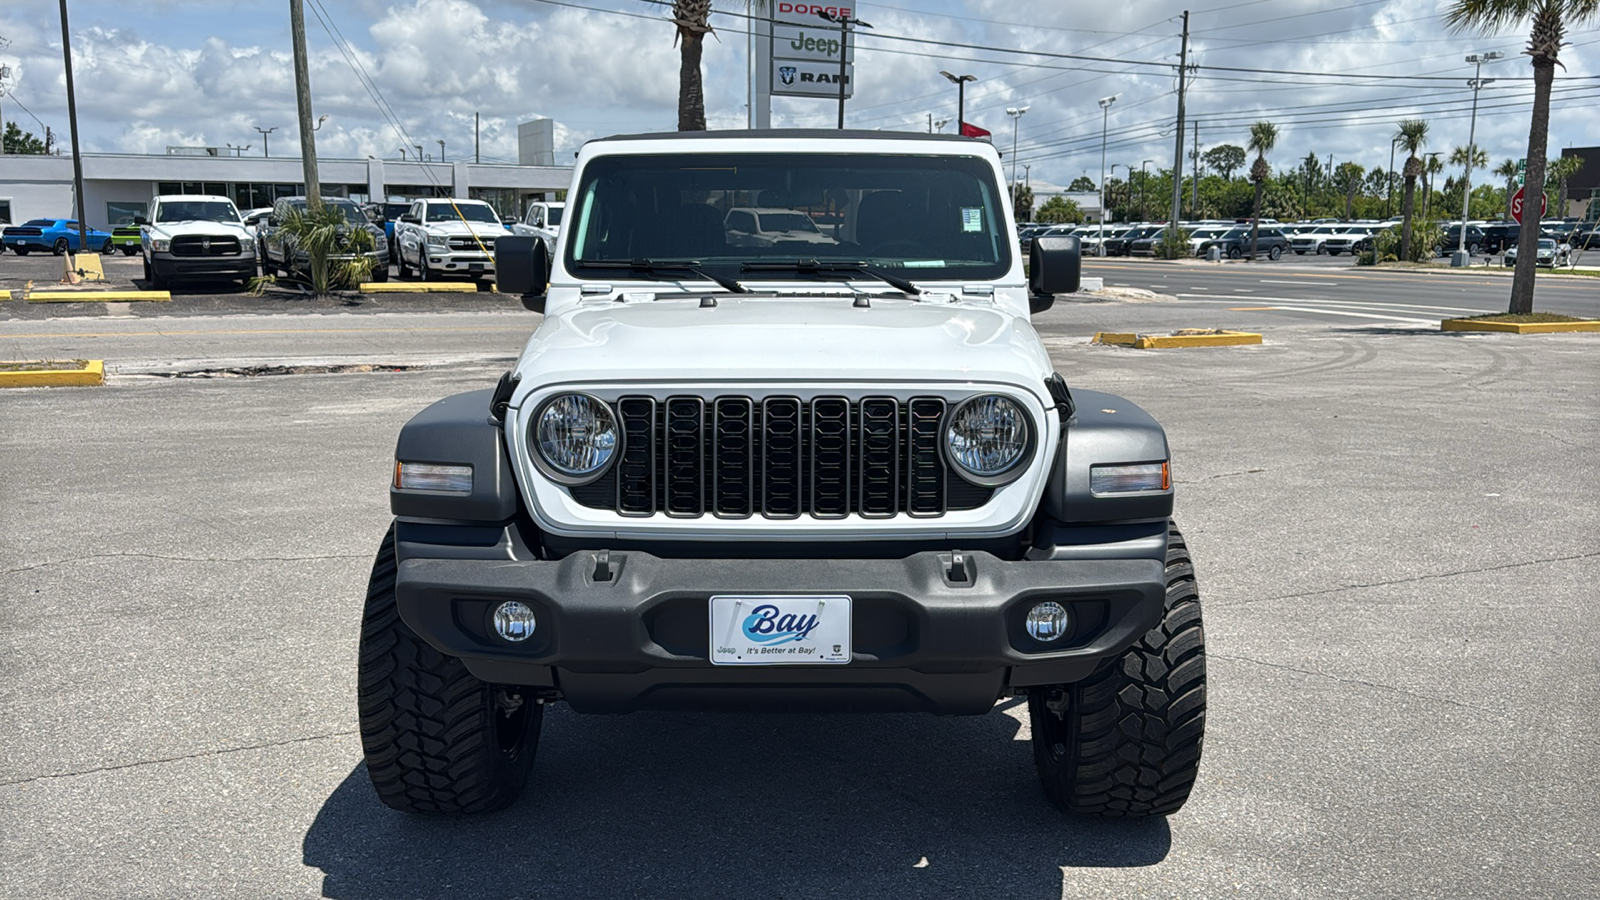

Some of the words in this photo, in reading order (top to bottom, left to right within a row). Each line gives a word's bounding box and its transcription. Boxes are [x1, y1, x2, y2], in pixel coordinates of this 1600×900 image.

[779, 3, 851, 18] DODGE
[791, 32, 839, 56] Jeep
[801, 72, 850, 84] RAM
[748, 604, 820, 641] Bay
[717, 646, 736, 654] Jeep
[798, 647, 816, 655] Bay!
